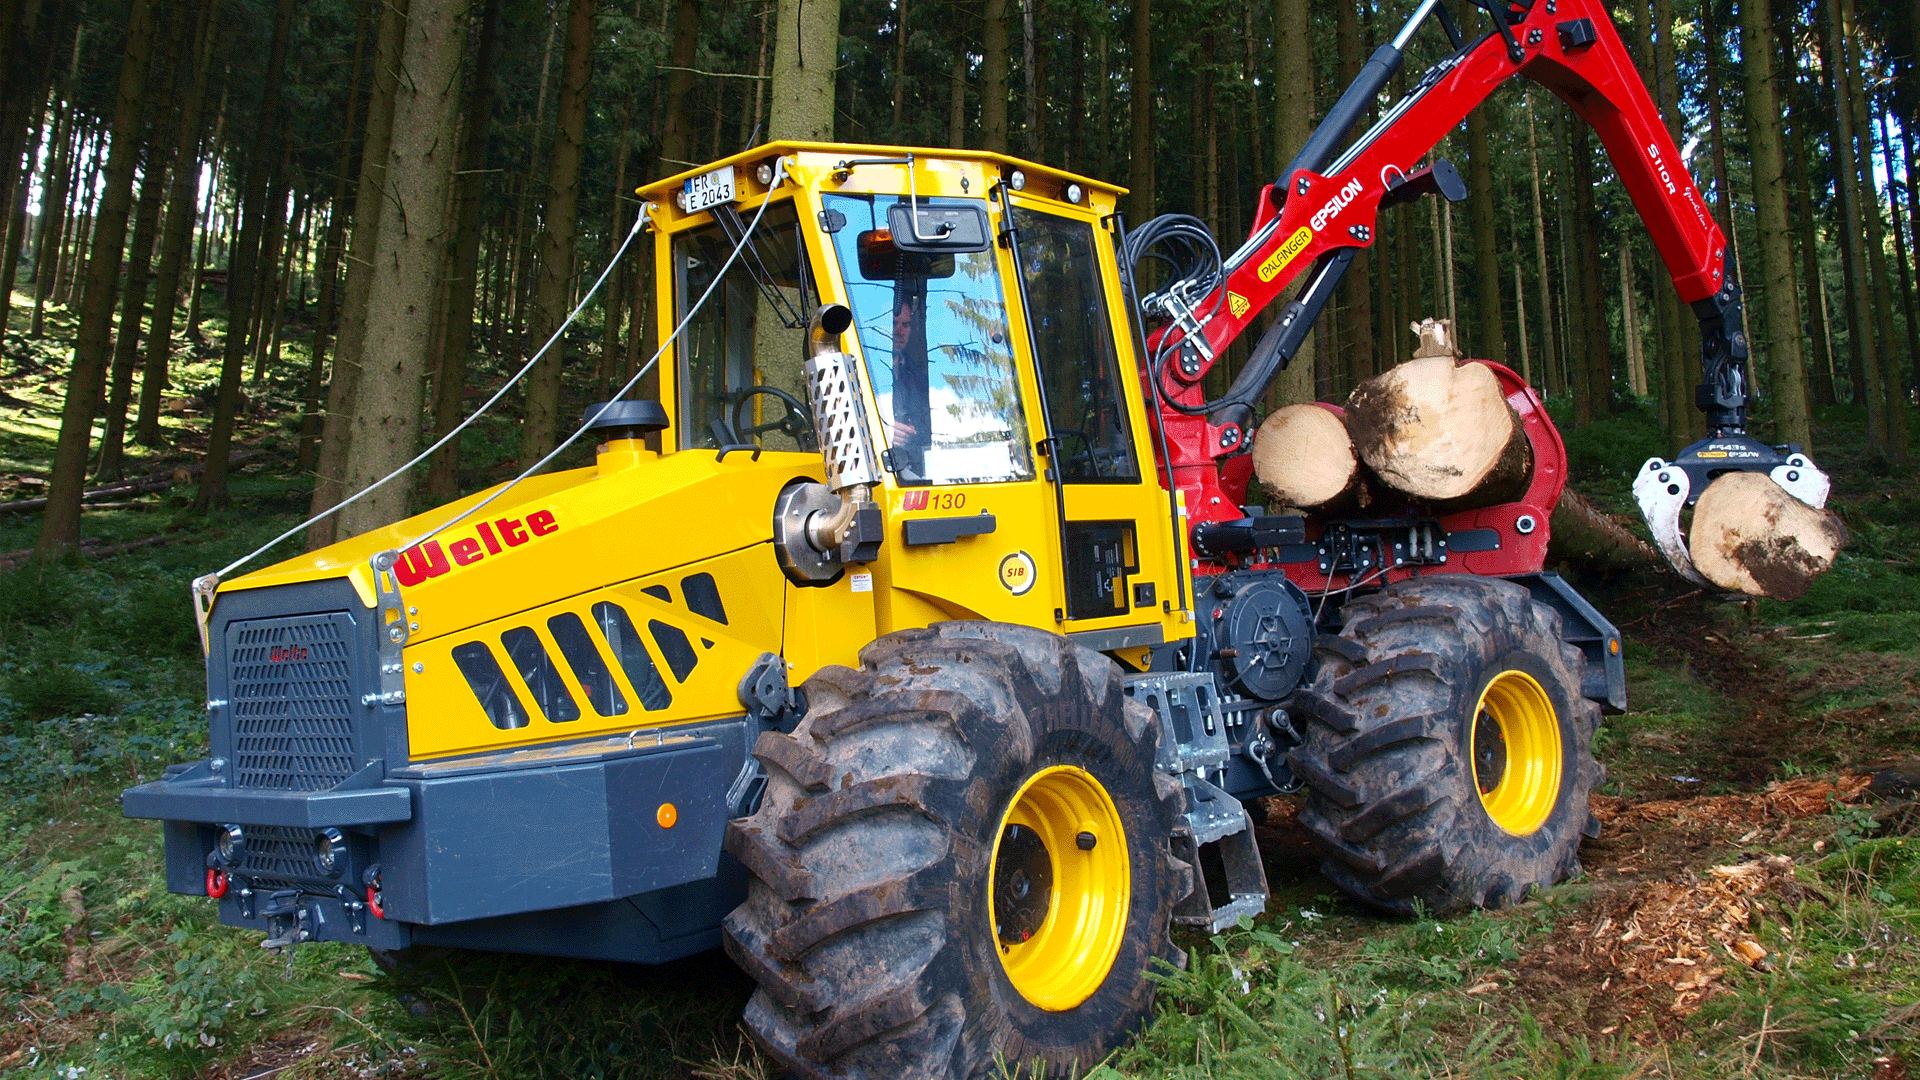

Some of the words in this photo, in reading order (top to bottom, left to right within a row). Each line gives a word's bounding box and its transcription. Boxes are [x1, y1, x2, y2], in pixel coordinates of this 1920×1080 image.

[1647, 143, 1676, 195] S110R
[693, 174, 709, 193] FR
[690, 195, 698, 210] E
[702, 183, 730, 206] 2043
[1261, 230, 1310, 279] PALFINGER
[1310, 177, 1364, 232] EPSILON
[903, 490, 930, 511] W
[932, 493, 966, 510] 130
[392, 509, 559, 588] Welte
[1006, 567, 1025, 578] SIB
[270, 645, 308, 662] Welte
